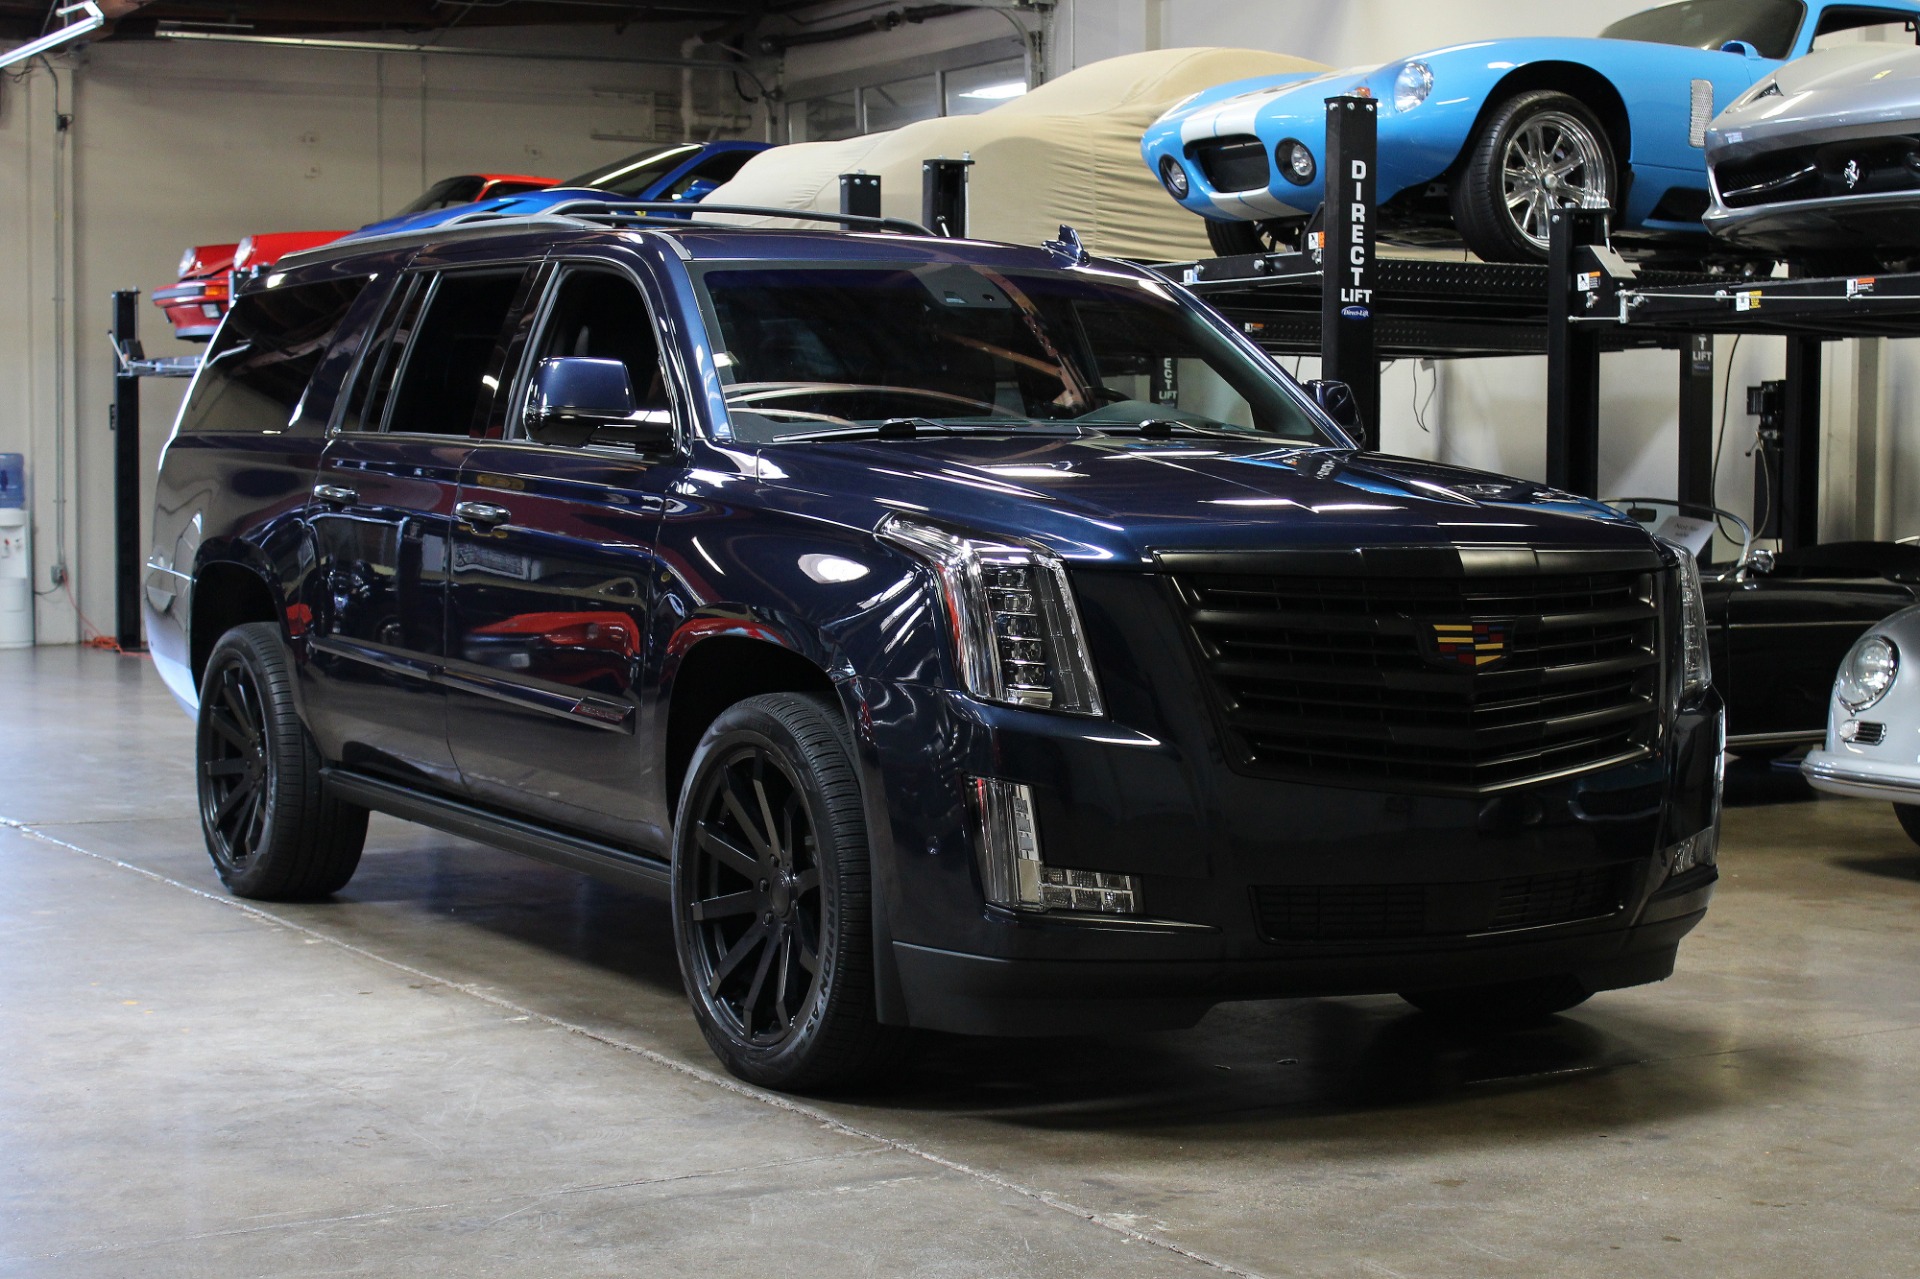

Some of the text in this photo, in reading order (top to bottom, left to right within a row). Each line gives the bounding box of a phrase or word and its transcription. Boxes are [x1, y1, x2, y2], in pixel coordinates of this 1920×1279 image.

[1350, 159, 1367, 287] DIRECT
[1340, 288, 1373, 303] LIFT
[1692, 350, 1712, 362] LIFT
[1163, 357, 1173, 390] ECT
[1159, 390, 1177, 400] LIFT
